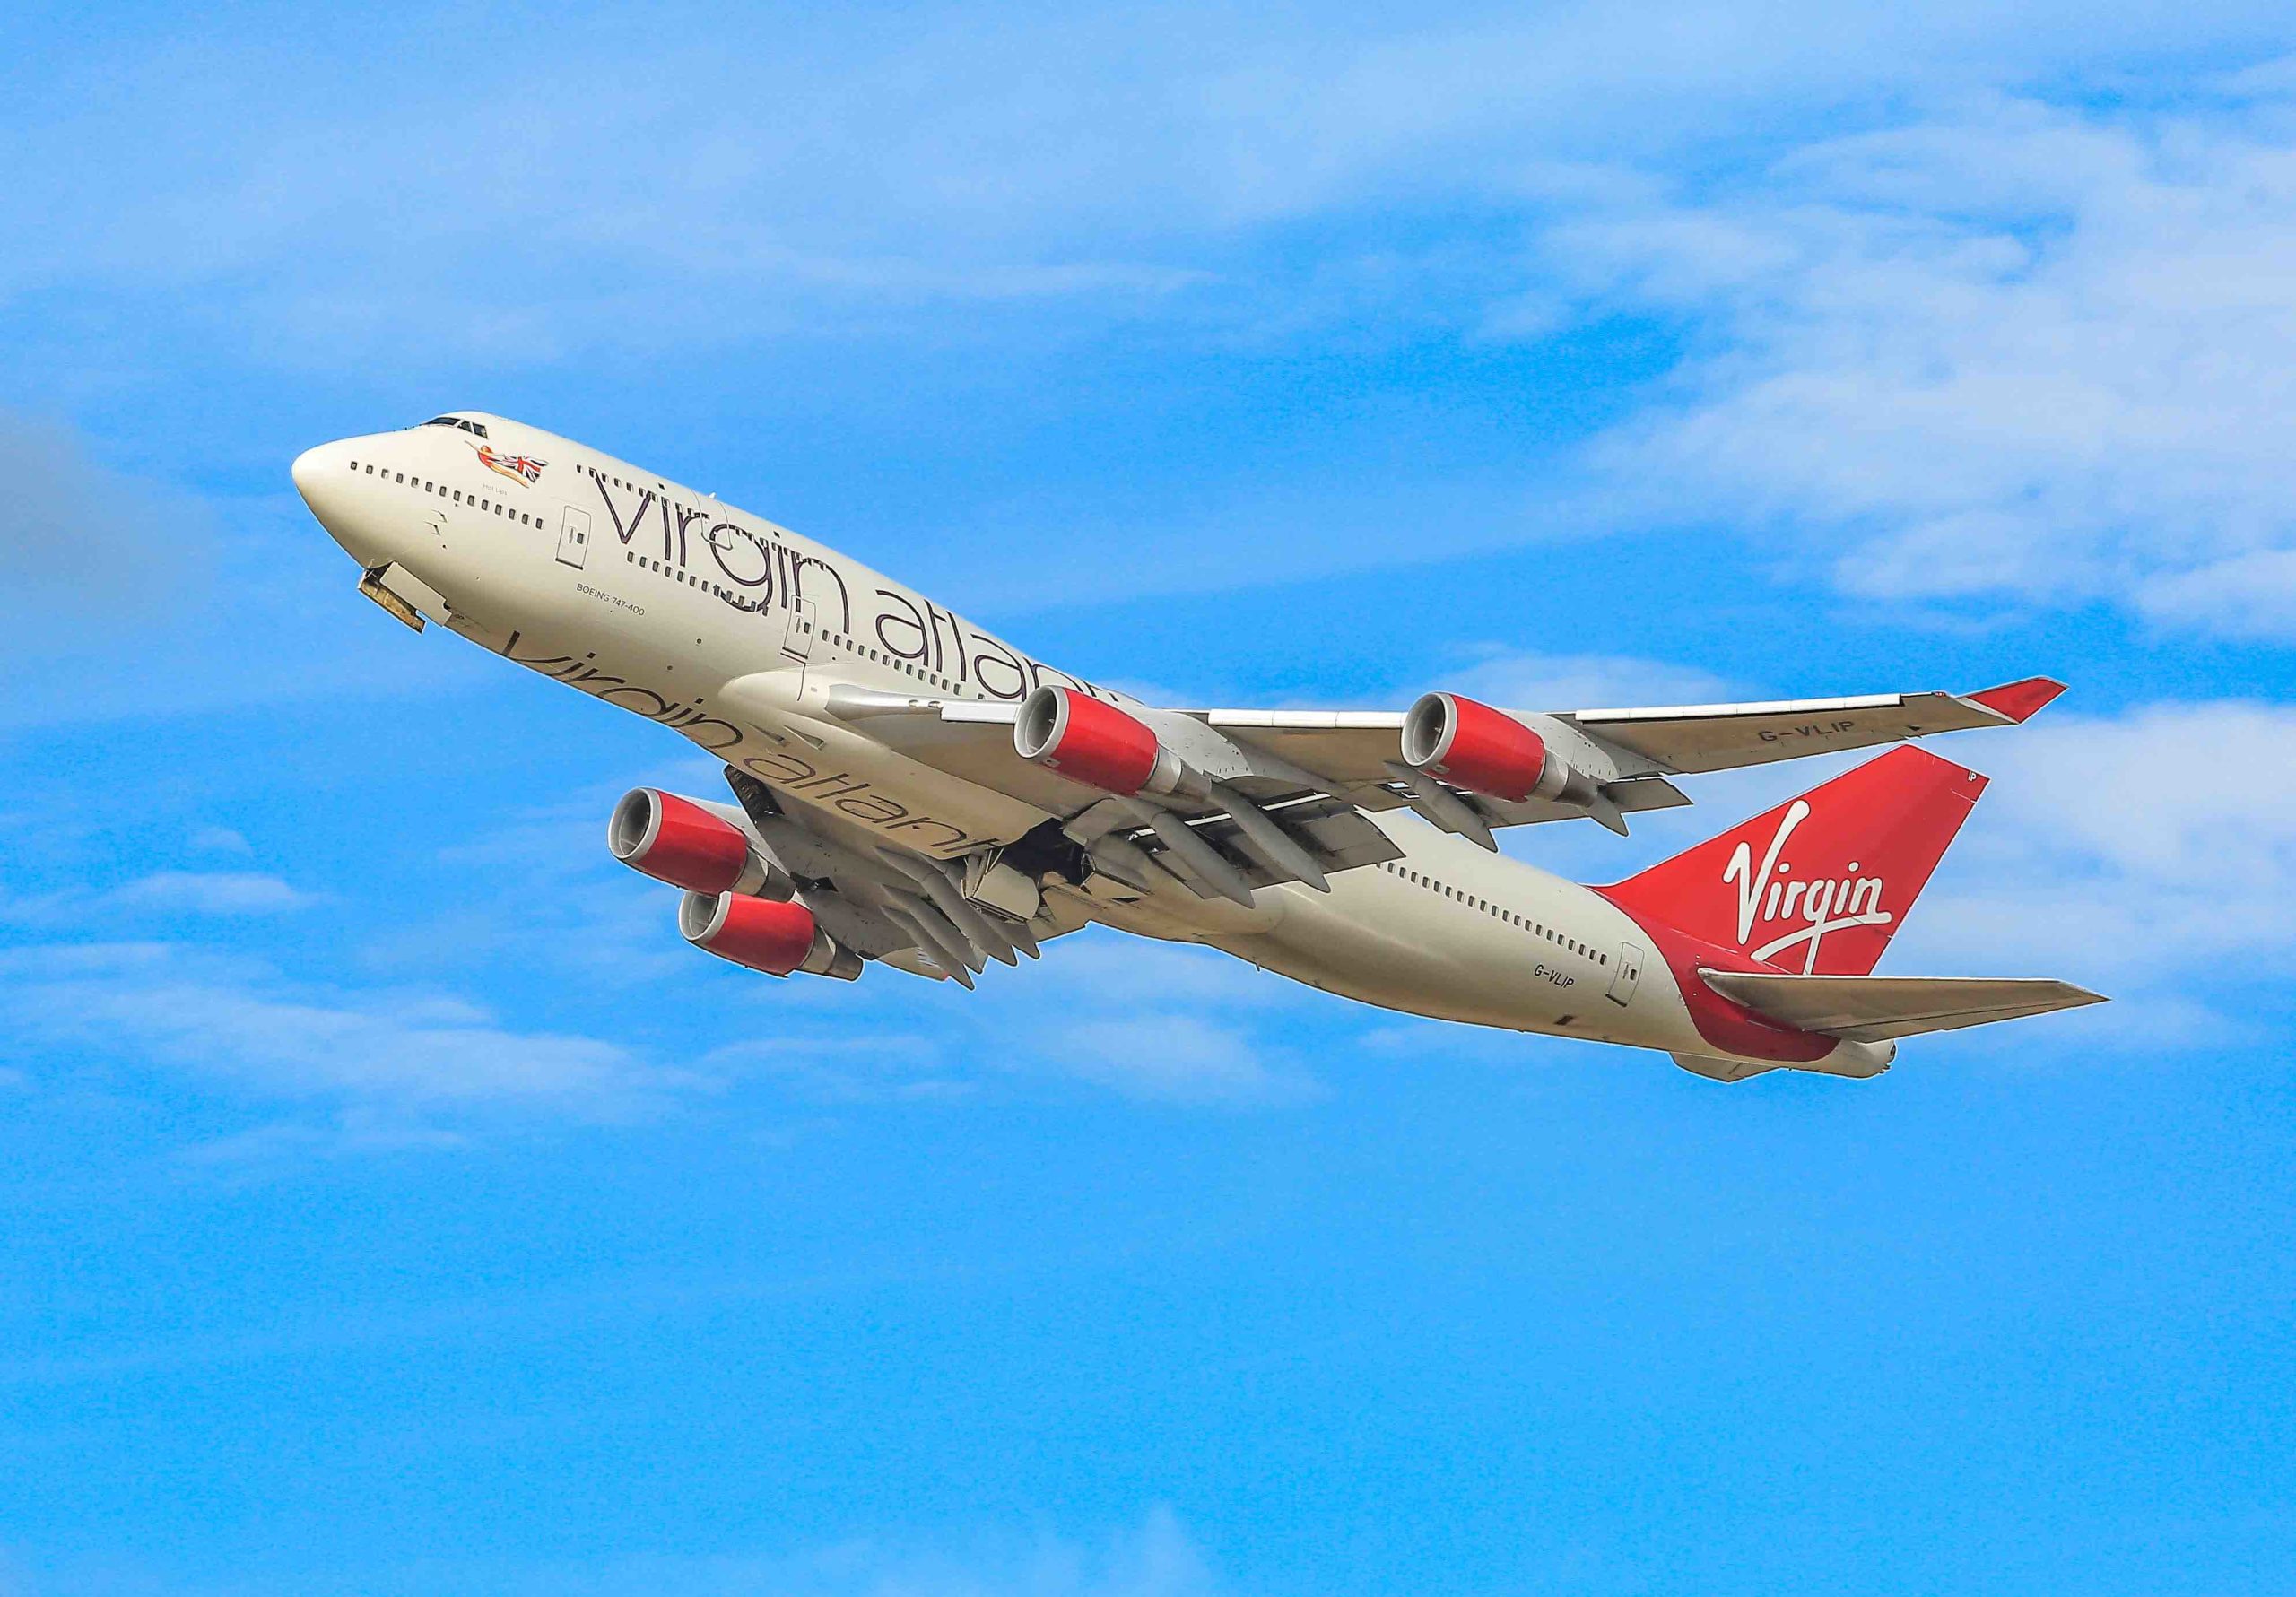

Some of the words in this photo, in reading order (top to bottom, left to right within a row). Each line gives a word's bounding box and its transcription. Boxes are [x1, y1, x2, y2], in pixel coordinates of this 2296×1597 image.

[576, 583, 611, 603] BOEING
[610, 596, 646, 616] 747-400
[589, 467, 850, 635] virgin
[875, 589, 1147, 705] atlan
[1759, 721, 1855, 742] G-VLIP
[1722, 799, 1893, 976] Virgin
[1534, 964, 1575, 989] G-VLIP
